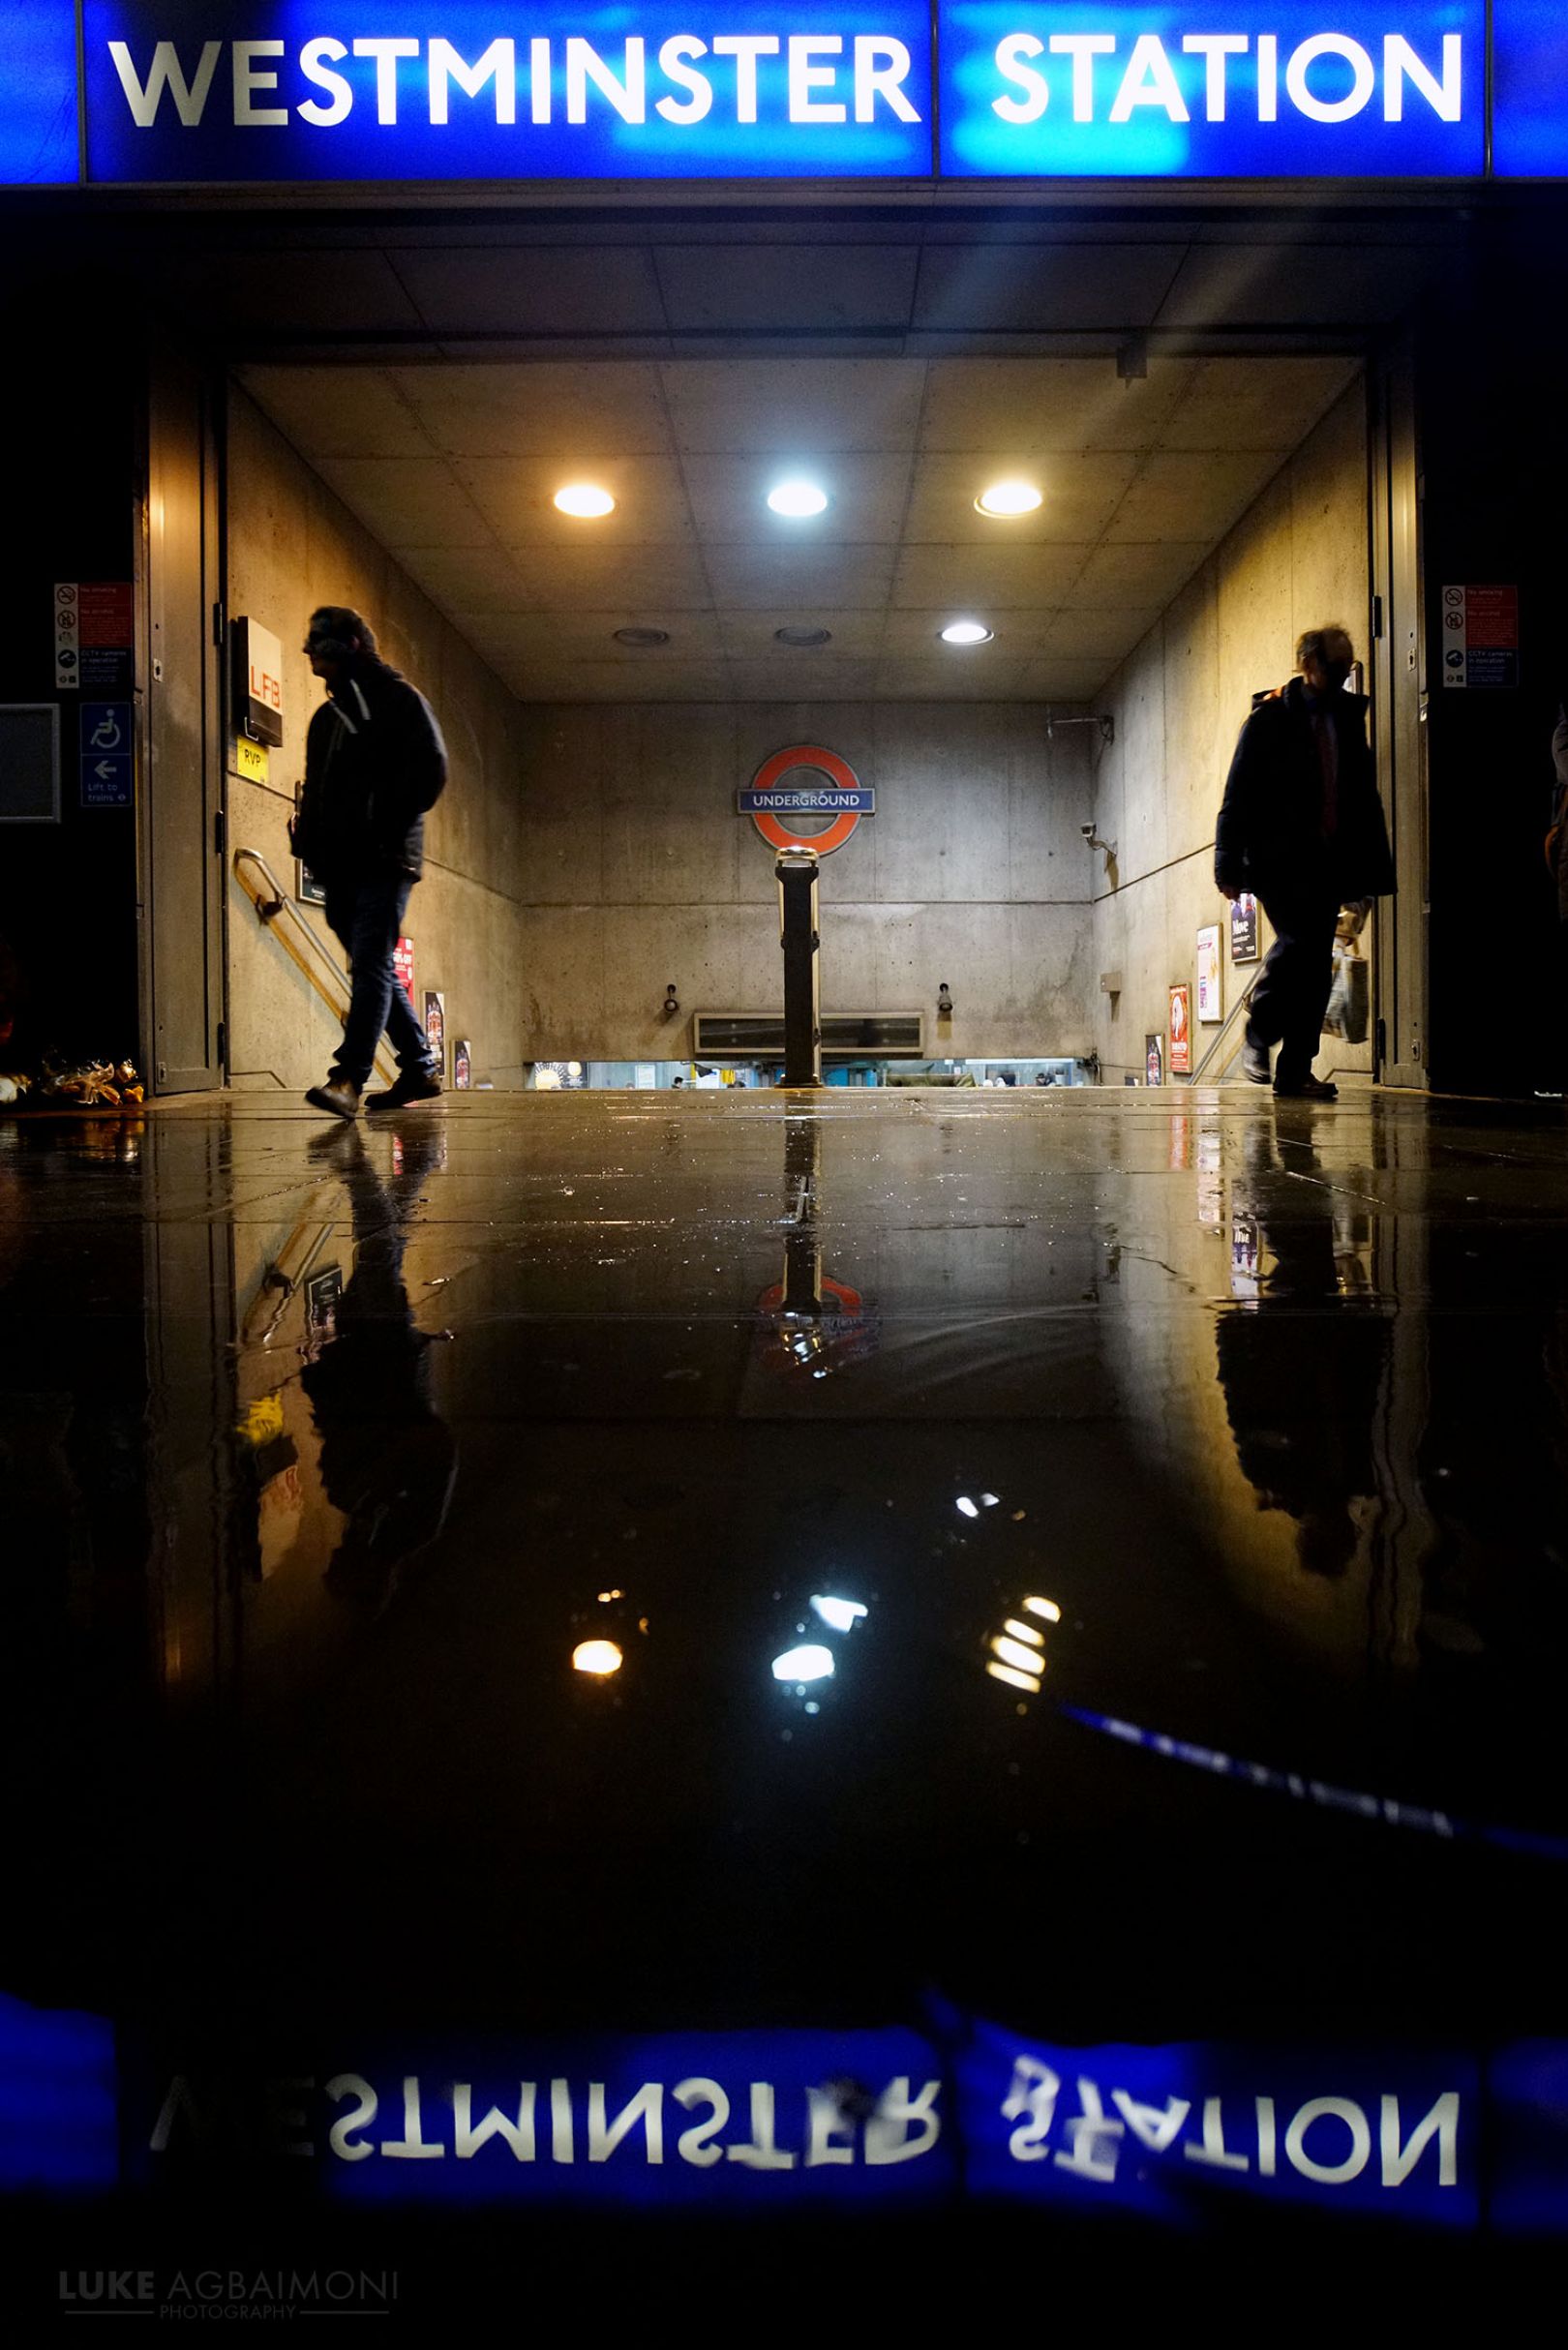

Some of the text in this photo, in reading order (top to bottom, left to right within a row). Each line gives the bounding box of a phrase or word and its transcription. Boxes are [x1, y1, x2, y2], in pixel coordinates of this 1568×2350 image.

[106, 31, 1462, 128] WESTMINSTER STATION
[251, 665, 281, 708] LFB
[244, 748, 261, 768] RVP
[753, 795, 859, 806] UNDERGROUND
